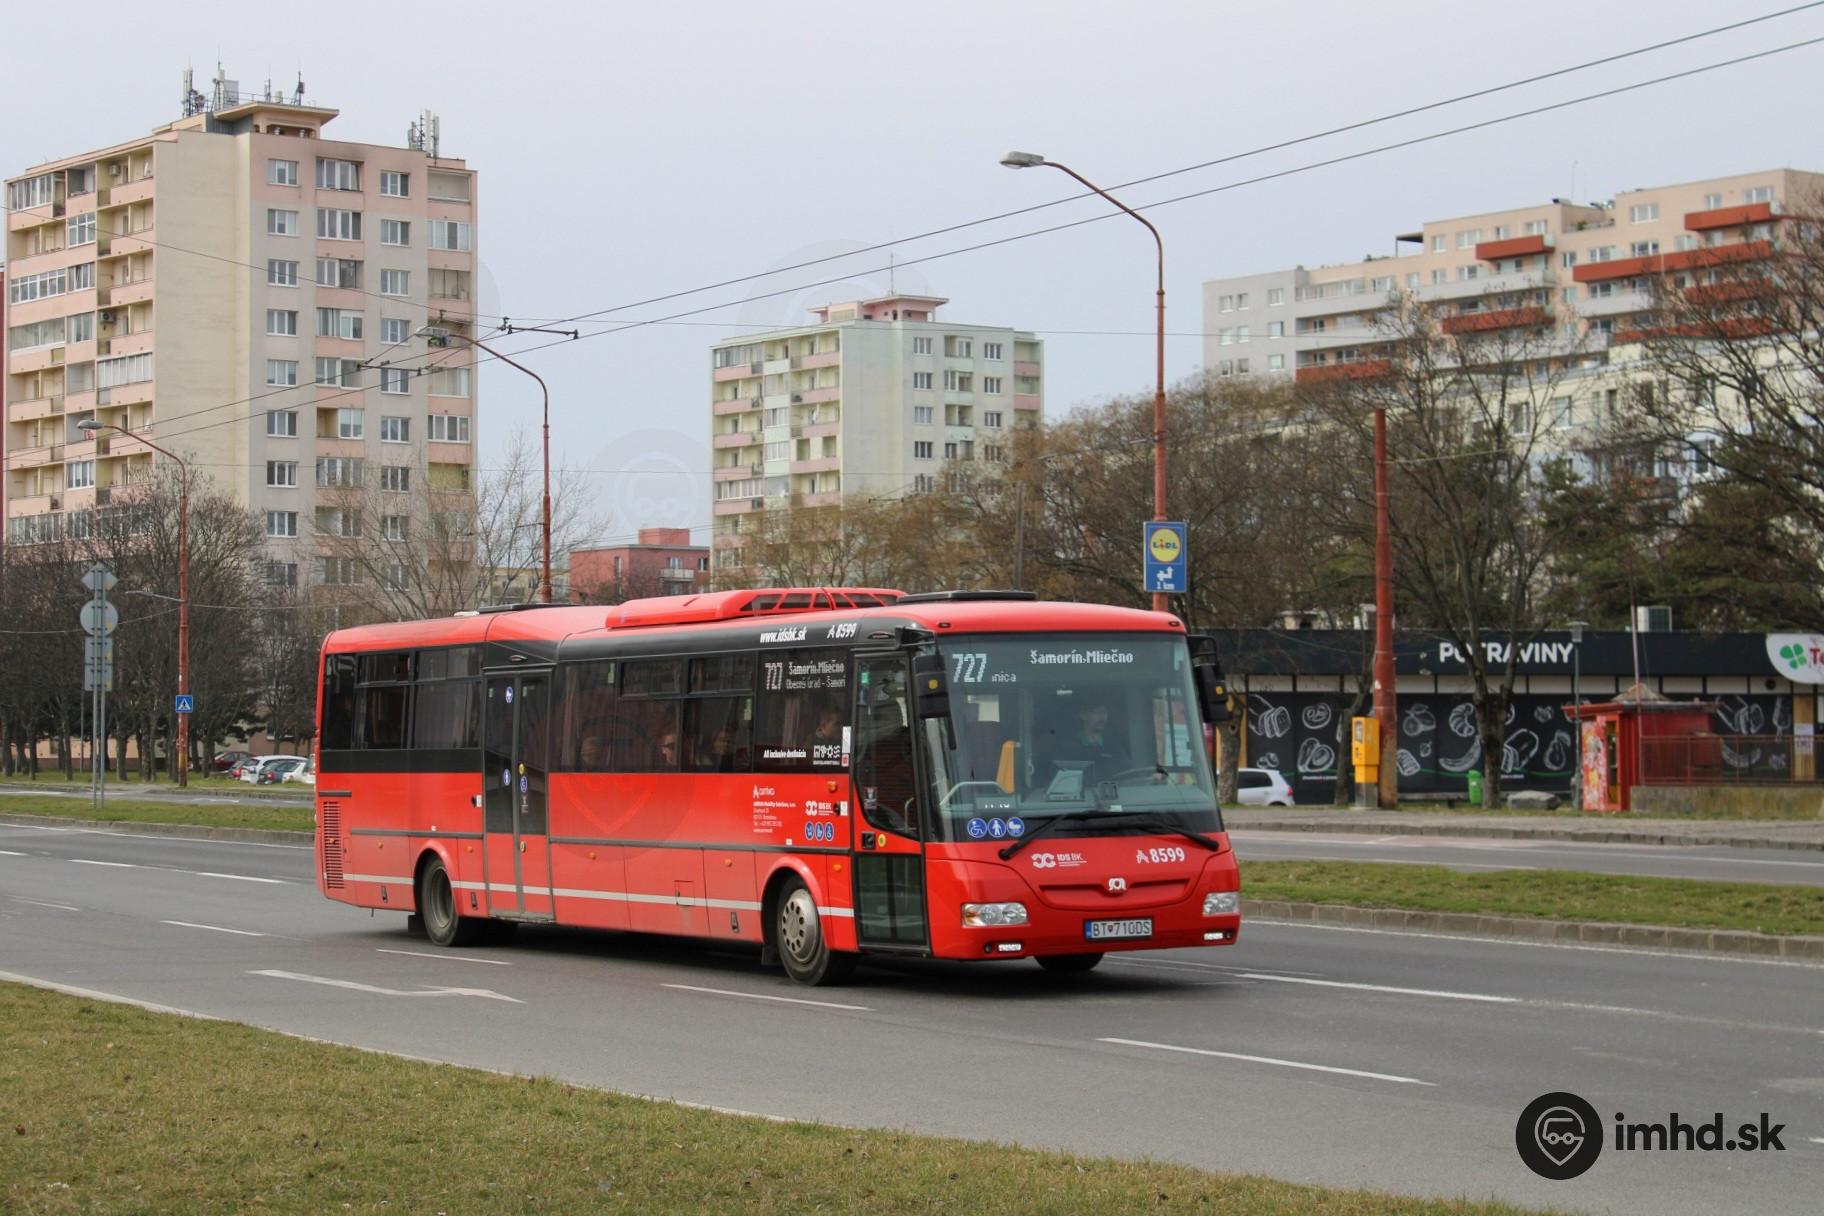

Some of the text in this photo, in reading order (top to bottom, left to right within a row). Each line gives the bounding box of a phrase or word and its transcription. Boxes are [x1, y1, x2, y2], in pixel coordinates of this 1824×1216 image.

[760, 626, 807, 643] www.idsbk.sk
[836, 622, 857, 639] 8599
[764, 662, 783, 690] 727
[952, 653, 987, 683] 727
[1149, 847, 1185, 863] 8599
[1093, 923, 1107, 936] BT
